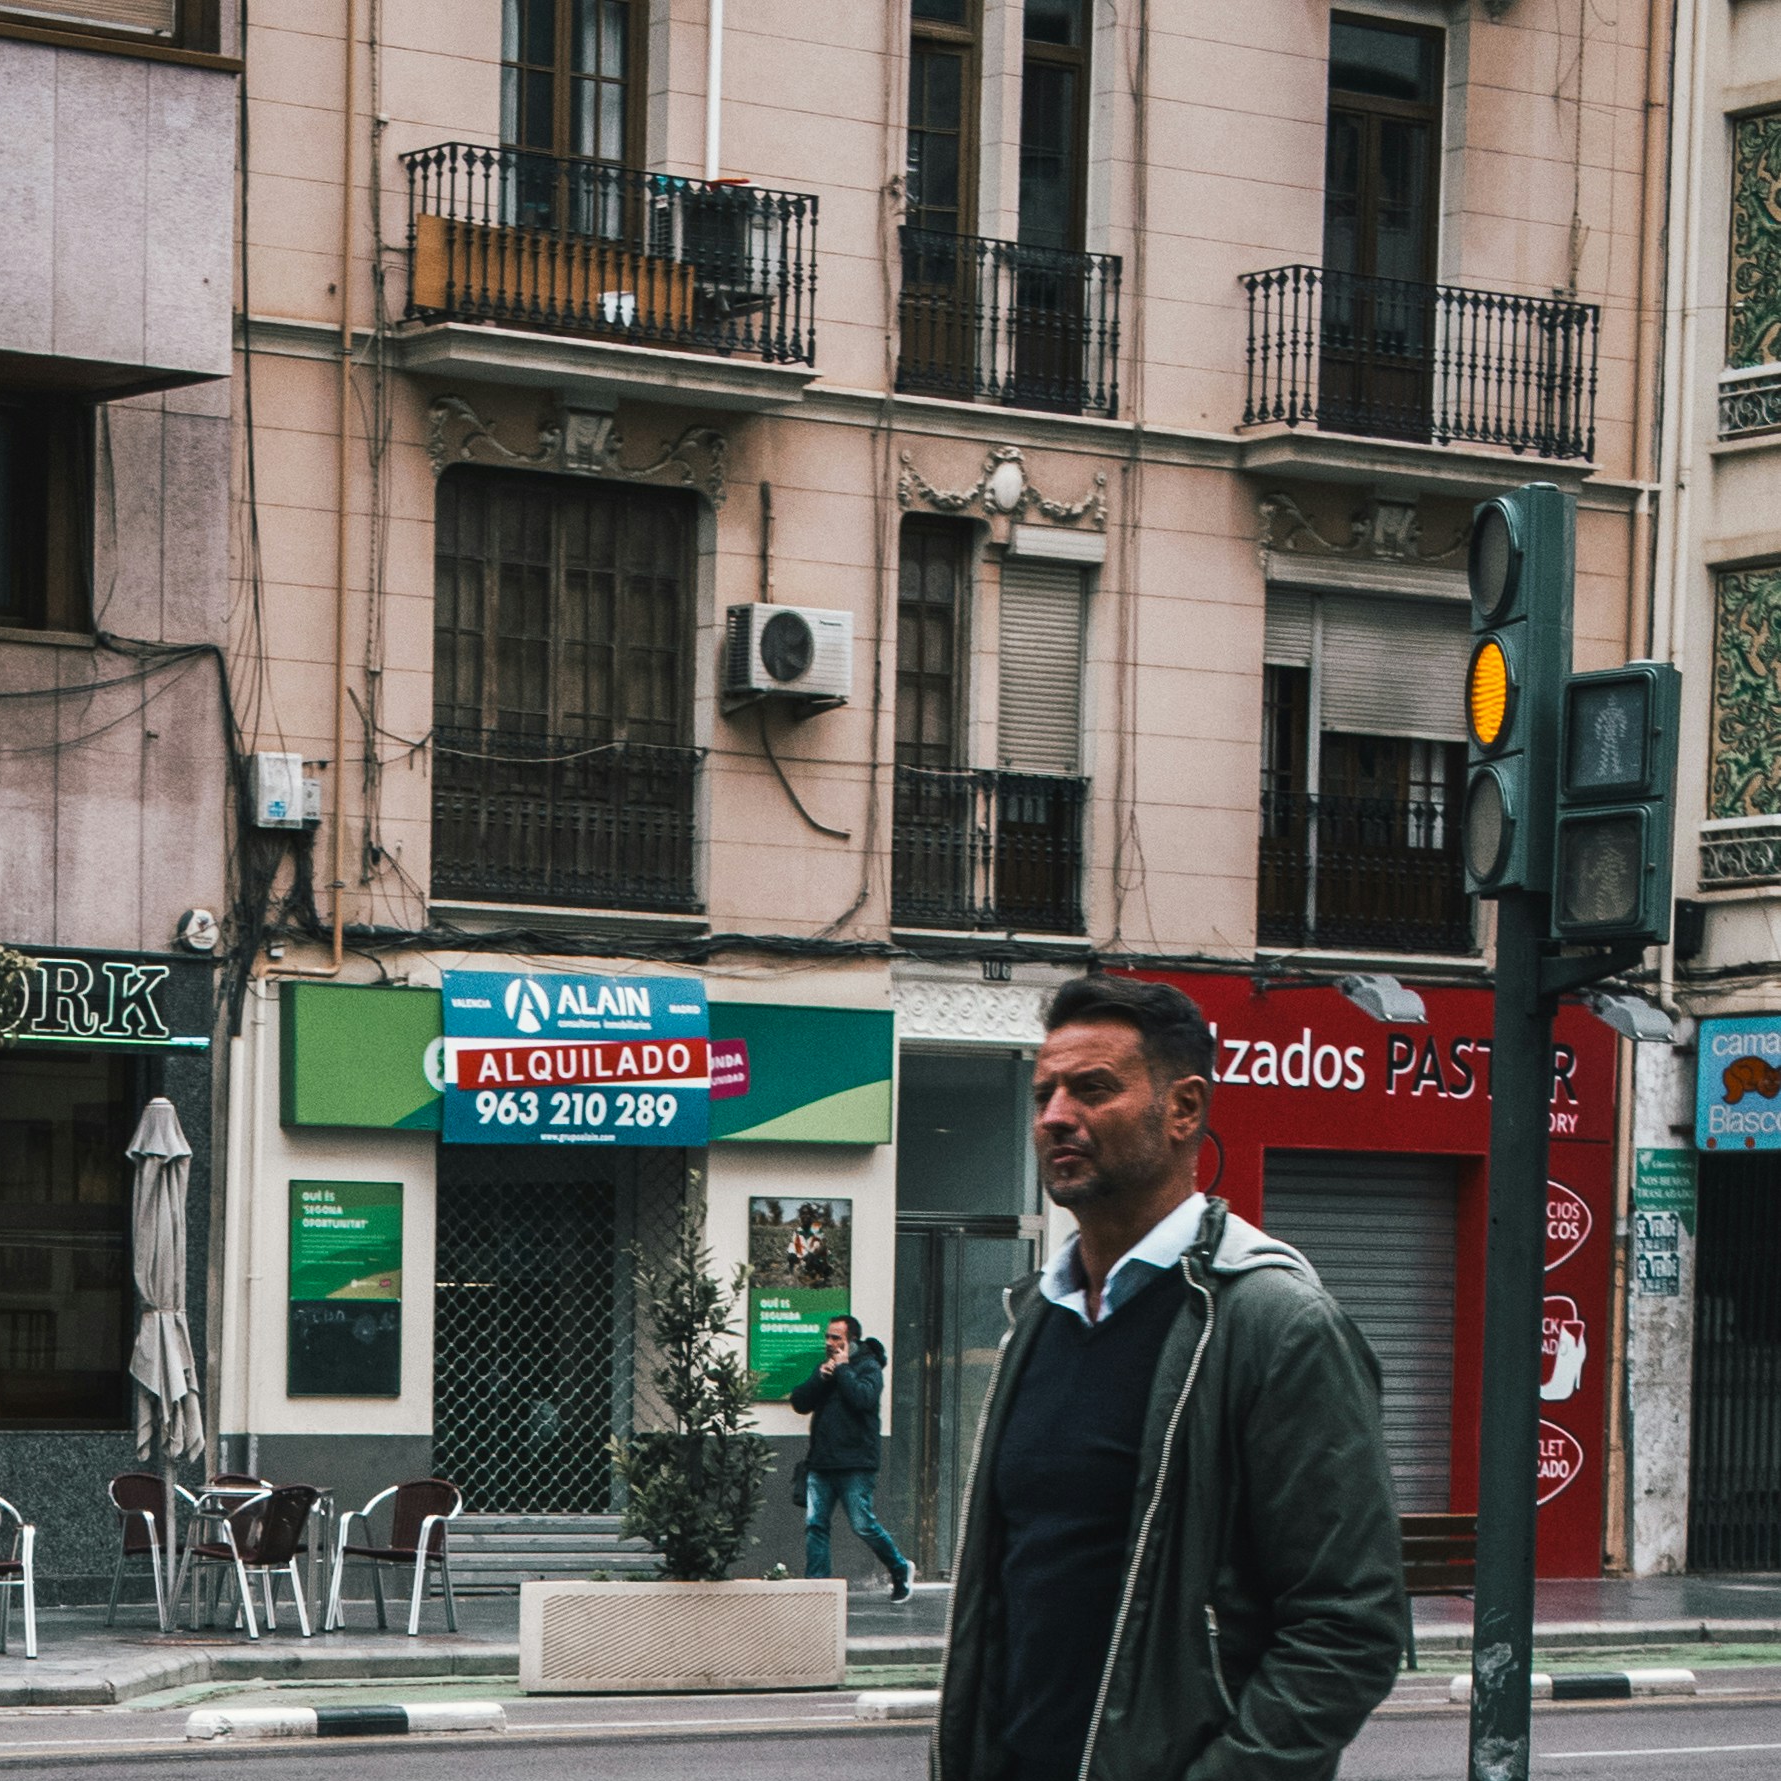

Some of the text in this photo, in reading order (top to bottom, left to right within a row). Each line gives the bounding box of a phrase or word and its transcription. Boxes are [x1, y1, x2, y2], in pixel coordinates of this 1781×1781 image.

[556, 984, 652, 1017] ALAIN
[1711, 1031, 1781, 1057] cama
[477, 1043, 691, 1084] ALQUILADO
[1386, 1032, 1580, 1106] PASTR
[475, 1090, 678, 1127] 963 210 289
[1546, 1200, 1581, 1220] CIOS
